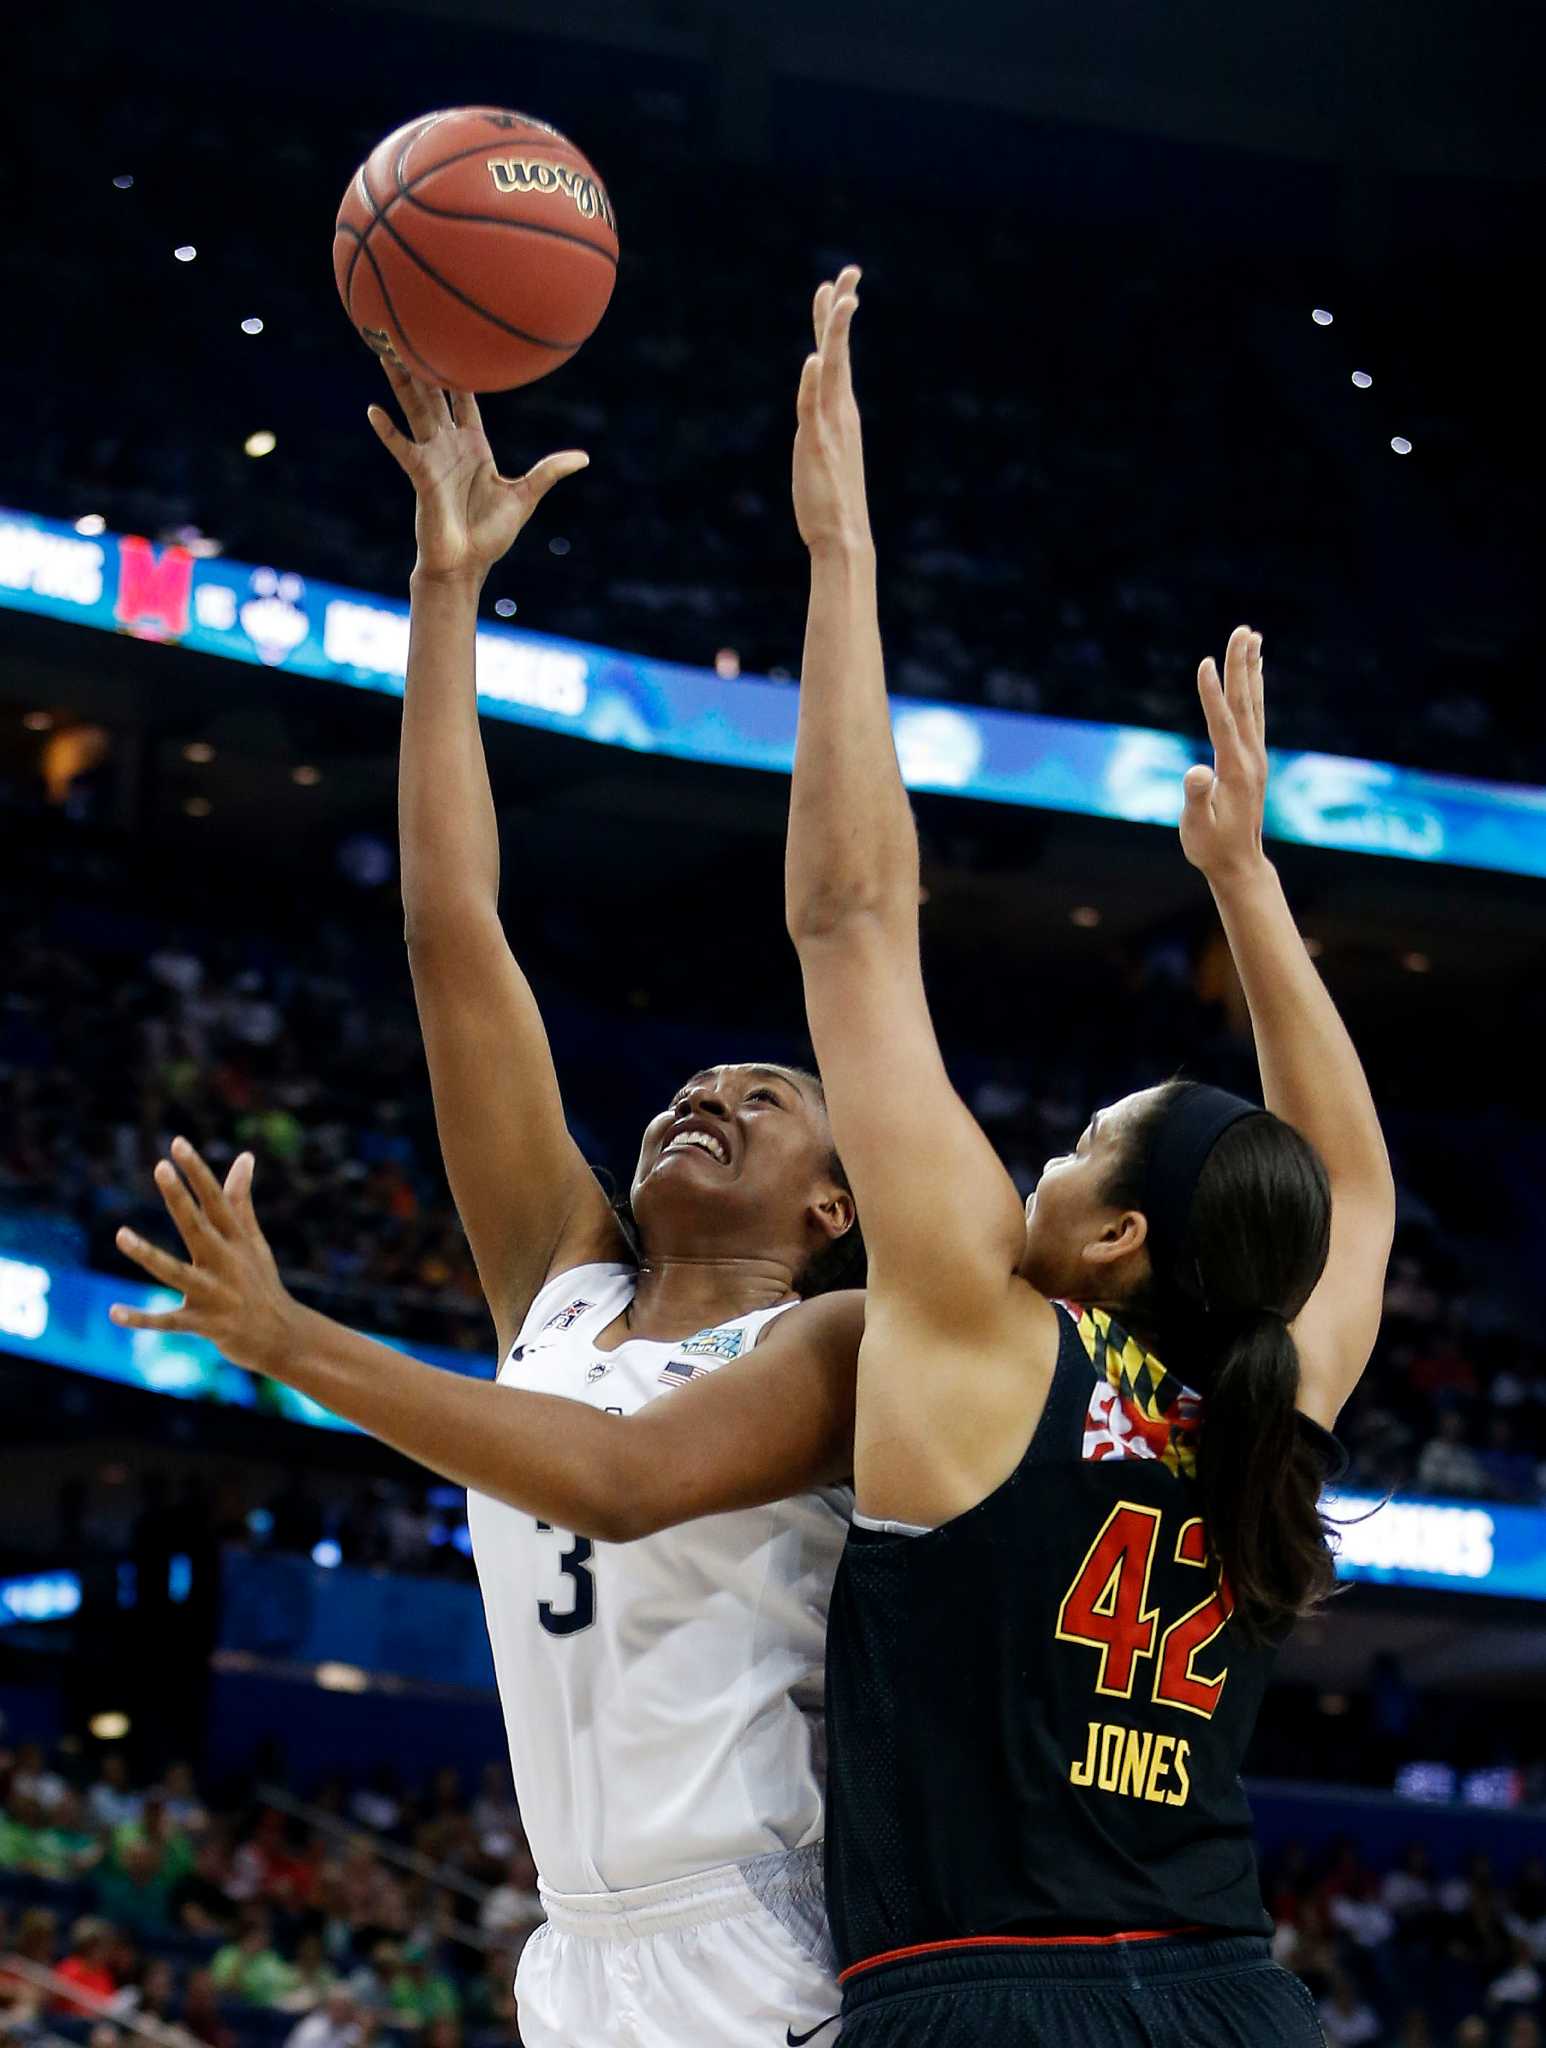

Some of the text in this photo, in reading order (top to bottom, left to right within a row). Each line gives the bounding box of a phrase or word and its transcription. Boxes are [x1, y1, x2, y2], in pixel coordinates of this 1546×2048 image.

[536, 1517, 597, 1638] 3
[1055, 1501, 1234, 1720] 42
[1070, 1721, 1191, 1807] JONES
